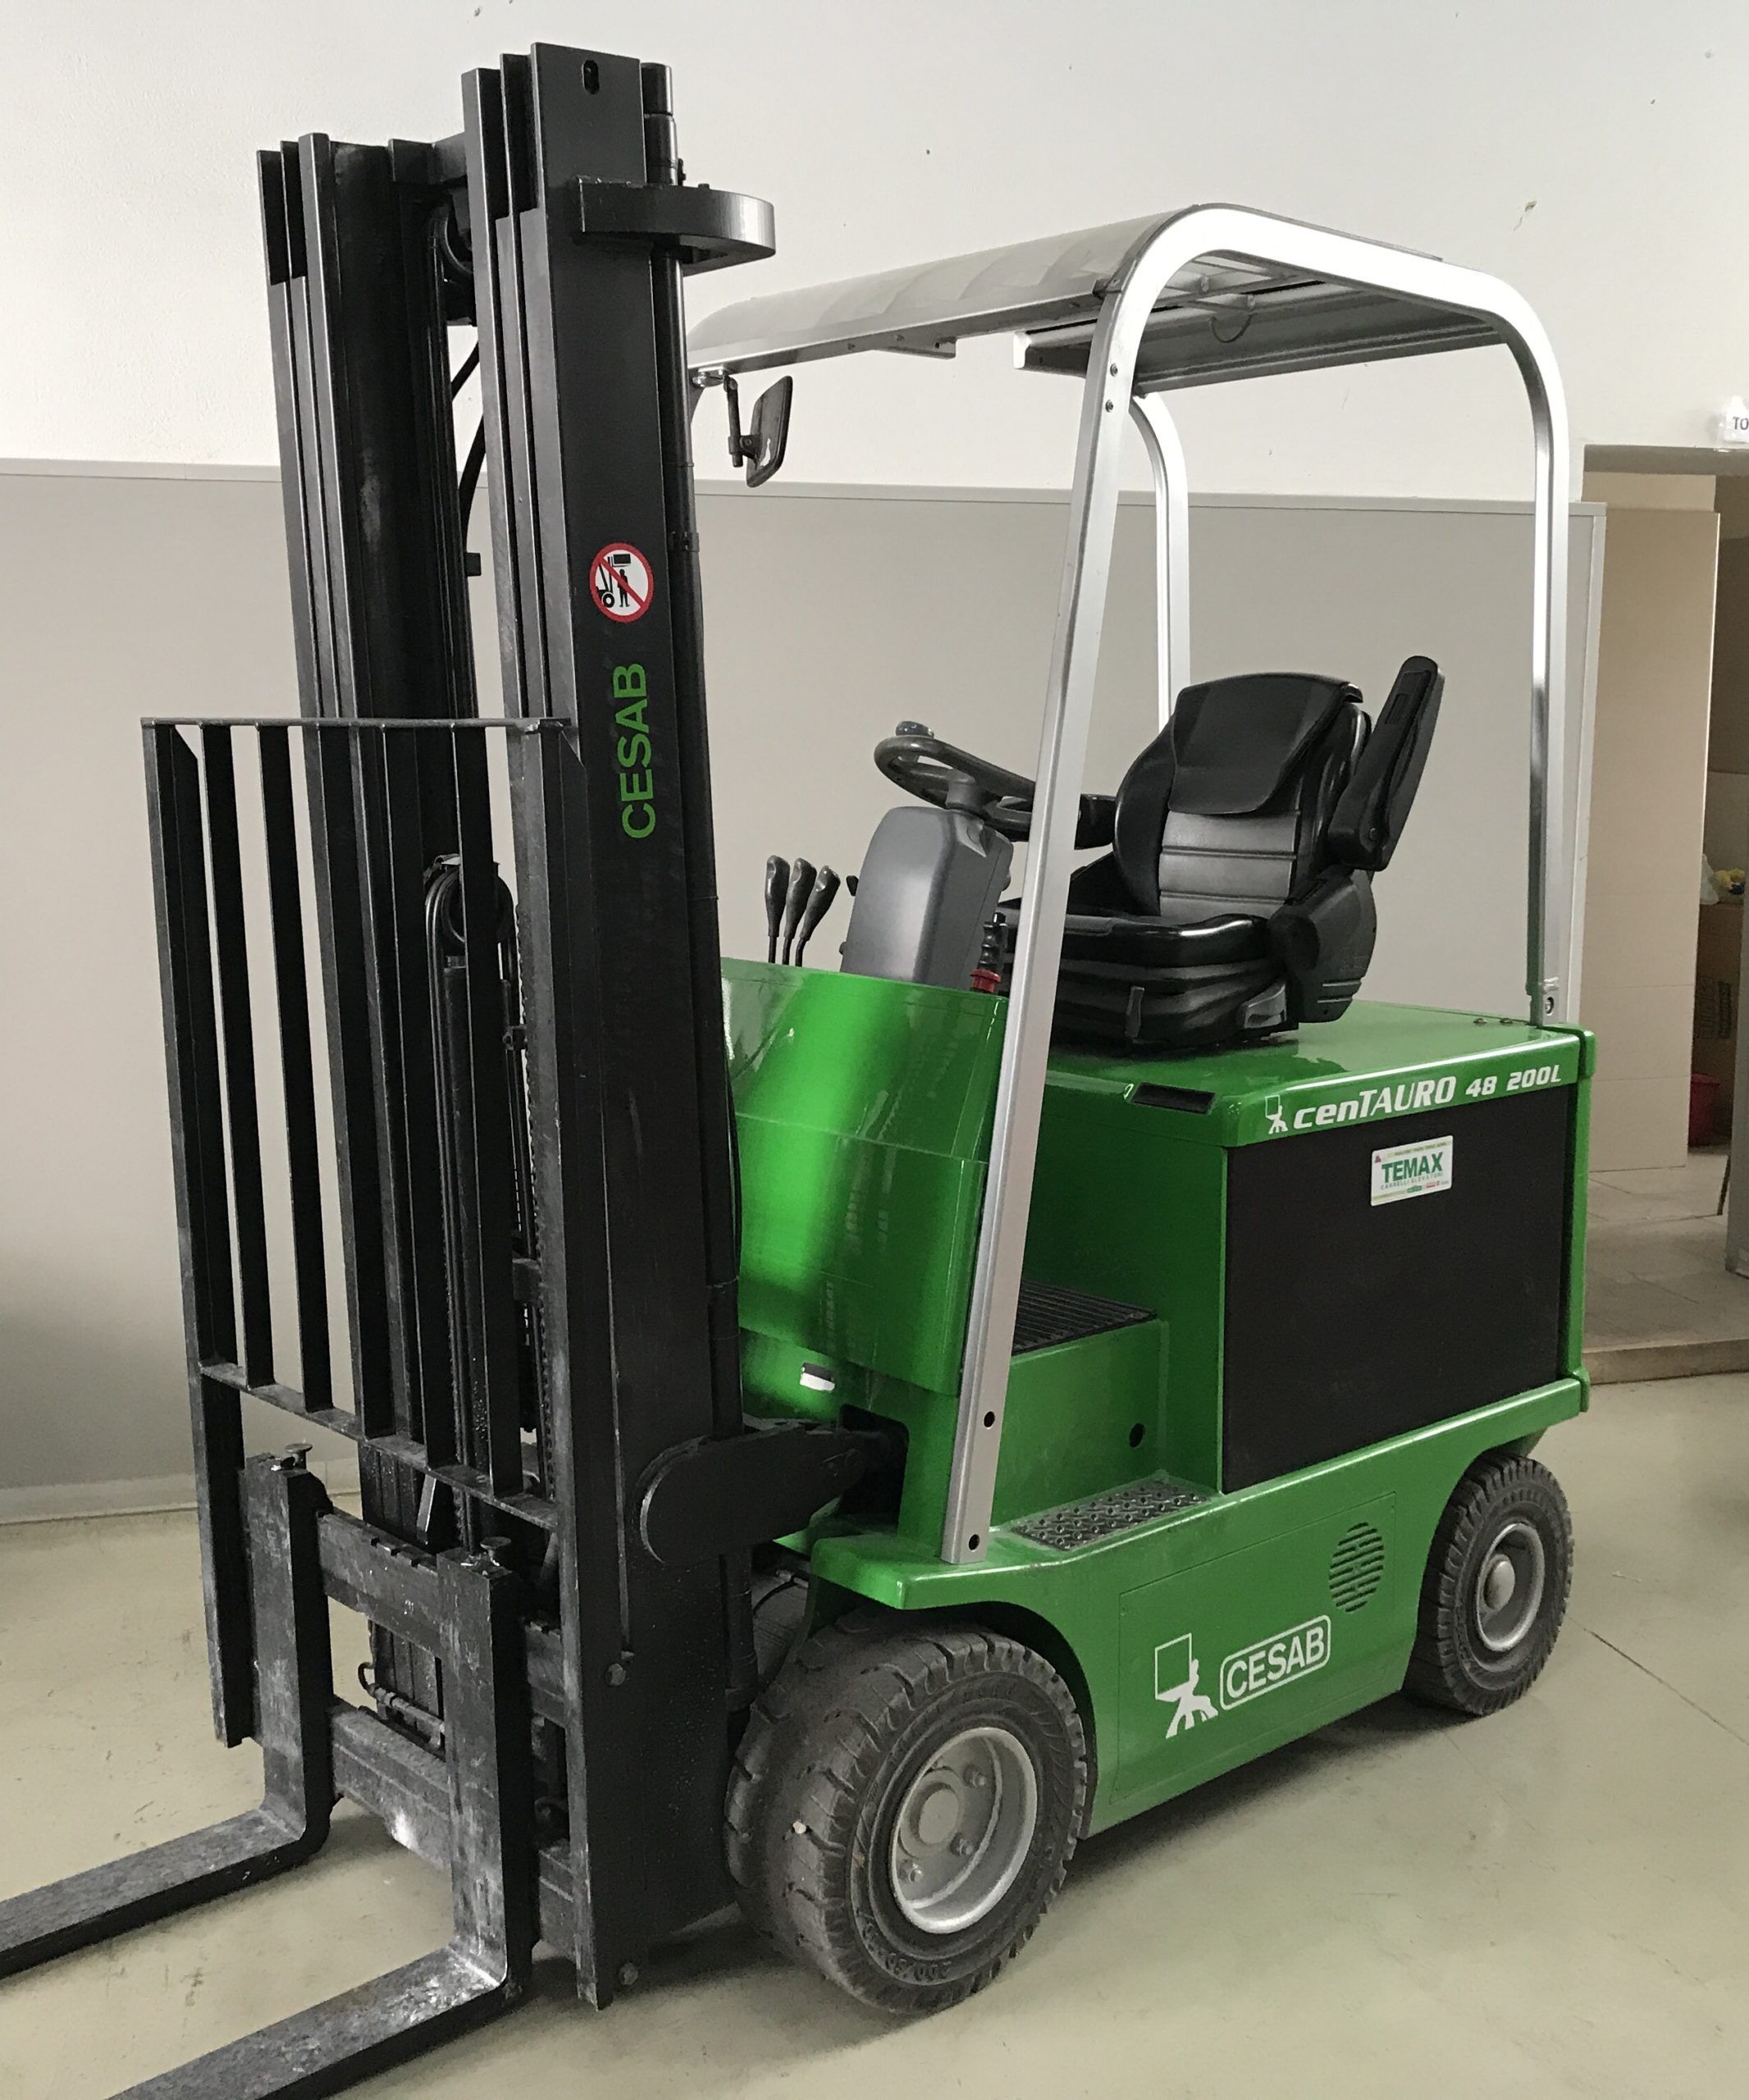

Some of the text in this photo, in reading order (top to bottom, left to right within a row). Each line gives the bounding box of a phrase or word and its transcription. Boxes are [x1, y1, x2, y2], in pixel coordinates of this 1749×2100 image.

[612, 663, 656, 838] CESAB
[1465, 1075, 1496, 1098] 48
[1506, 1065, 1561, 1091] 200L
[1381, 1152, 1443, 1183] TEMAX
[1226, 1626, 1325, 1699] CESAB
